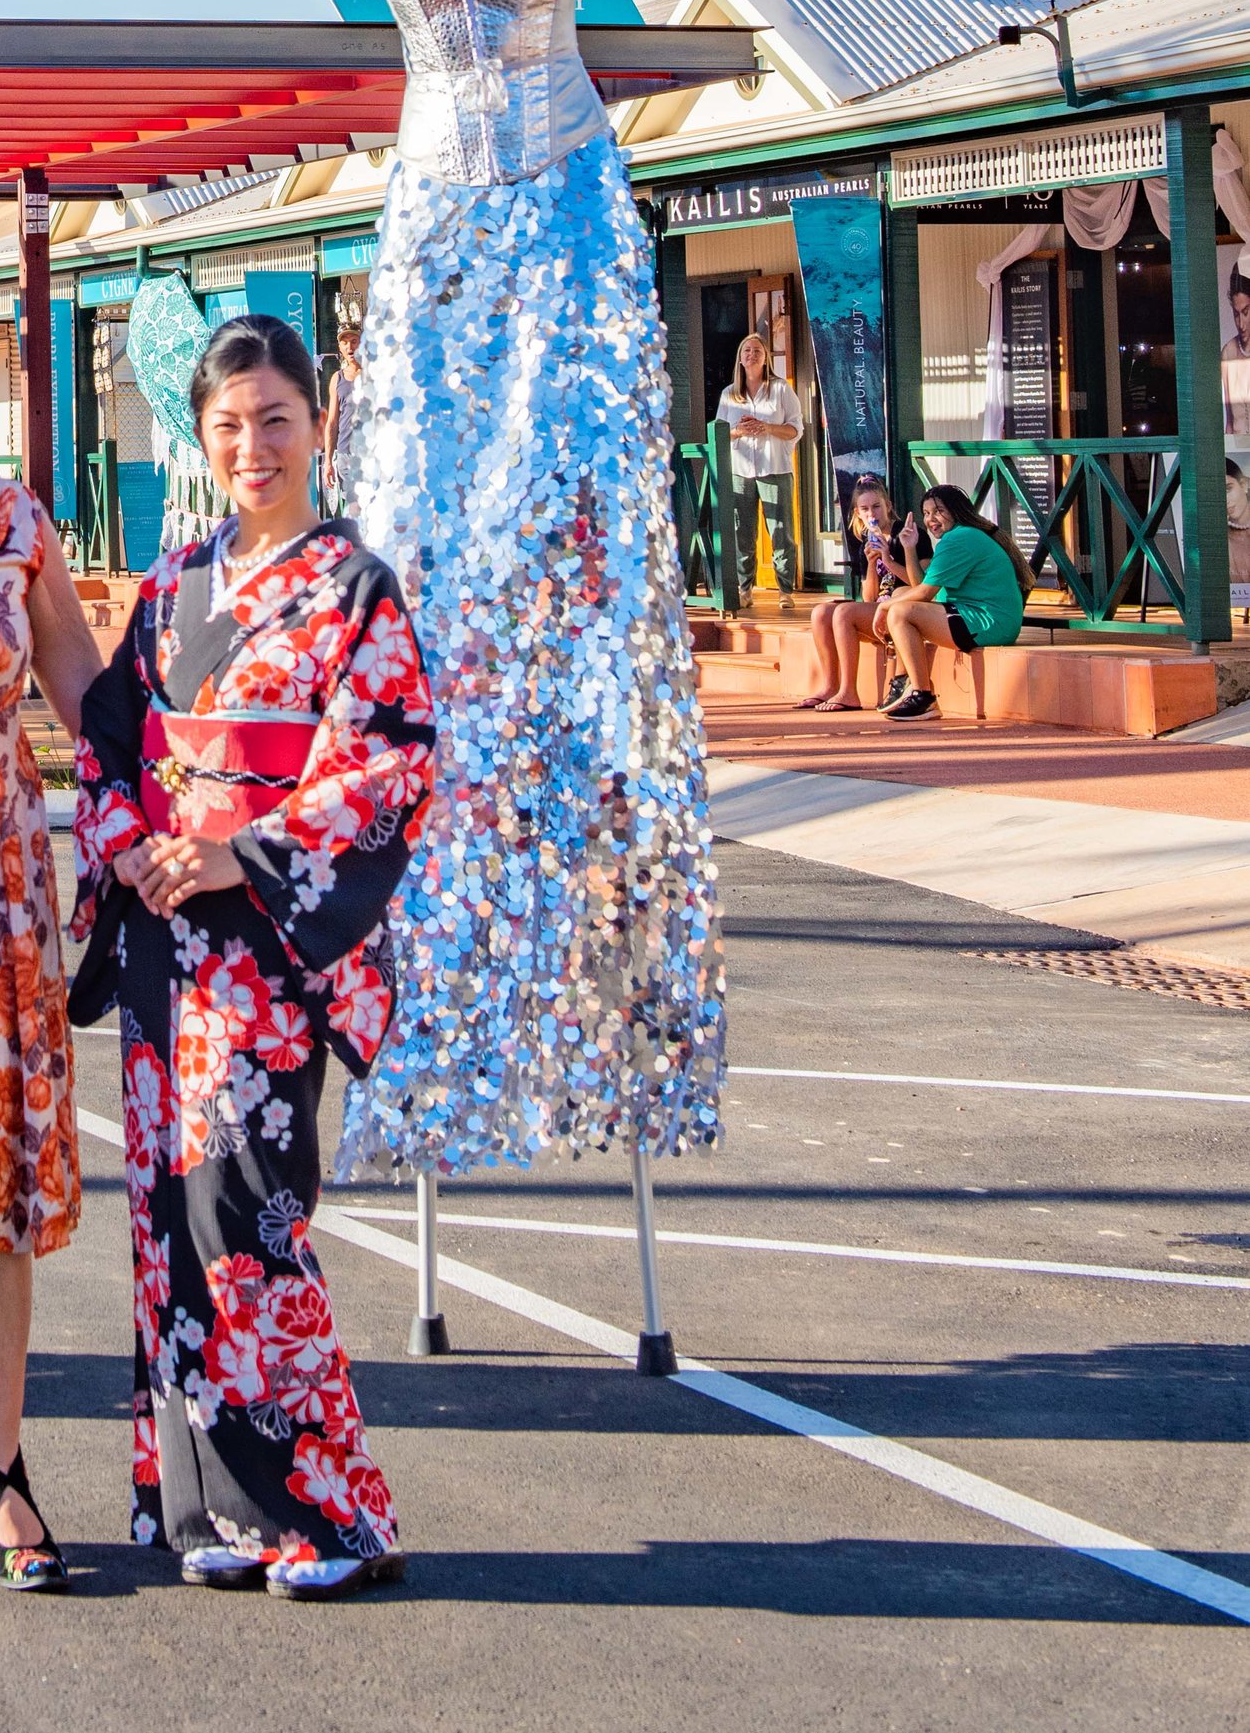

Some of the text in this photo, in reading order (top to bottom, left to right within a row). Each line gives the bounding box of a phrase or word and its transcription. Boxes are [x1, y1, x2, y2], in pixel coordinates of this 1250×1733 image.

[669, 178, 871, 222] KAILIS AUSTRALIAN PEARLS
[1020, 275, 1031, 283] THE
[1026, 285, 1042, 293] STORY
[852, 297, 867, 428] NATURAL. BEAUTY.
